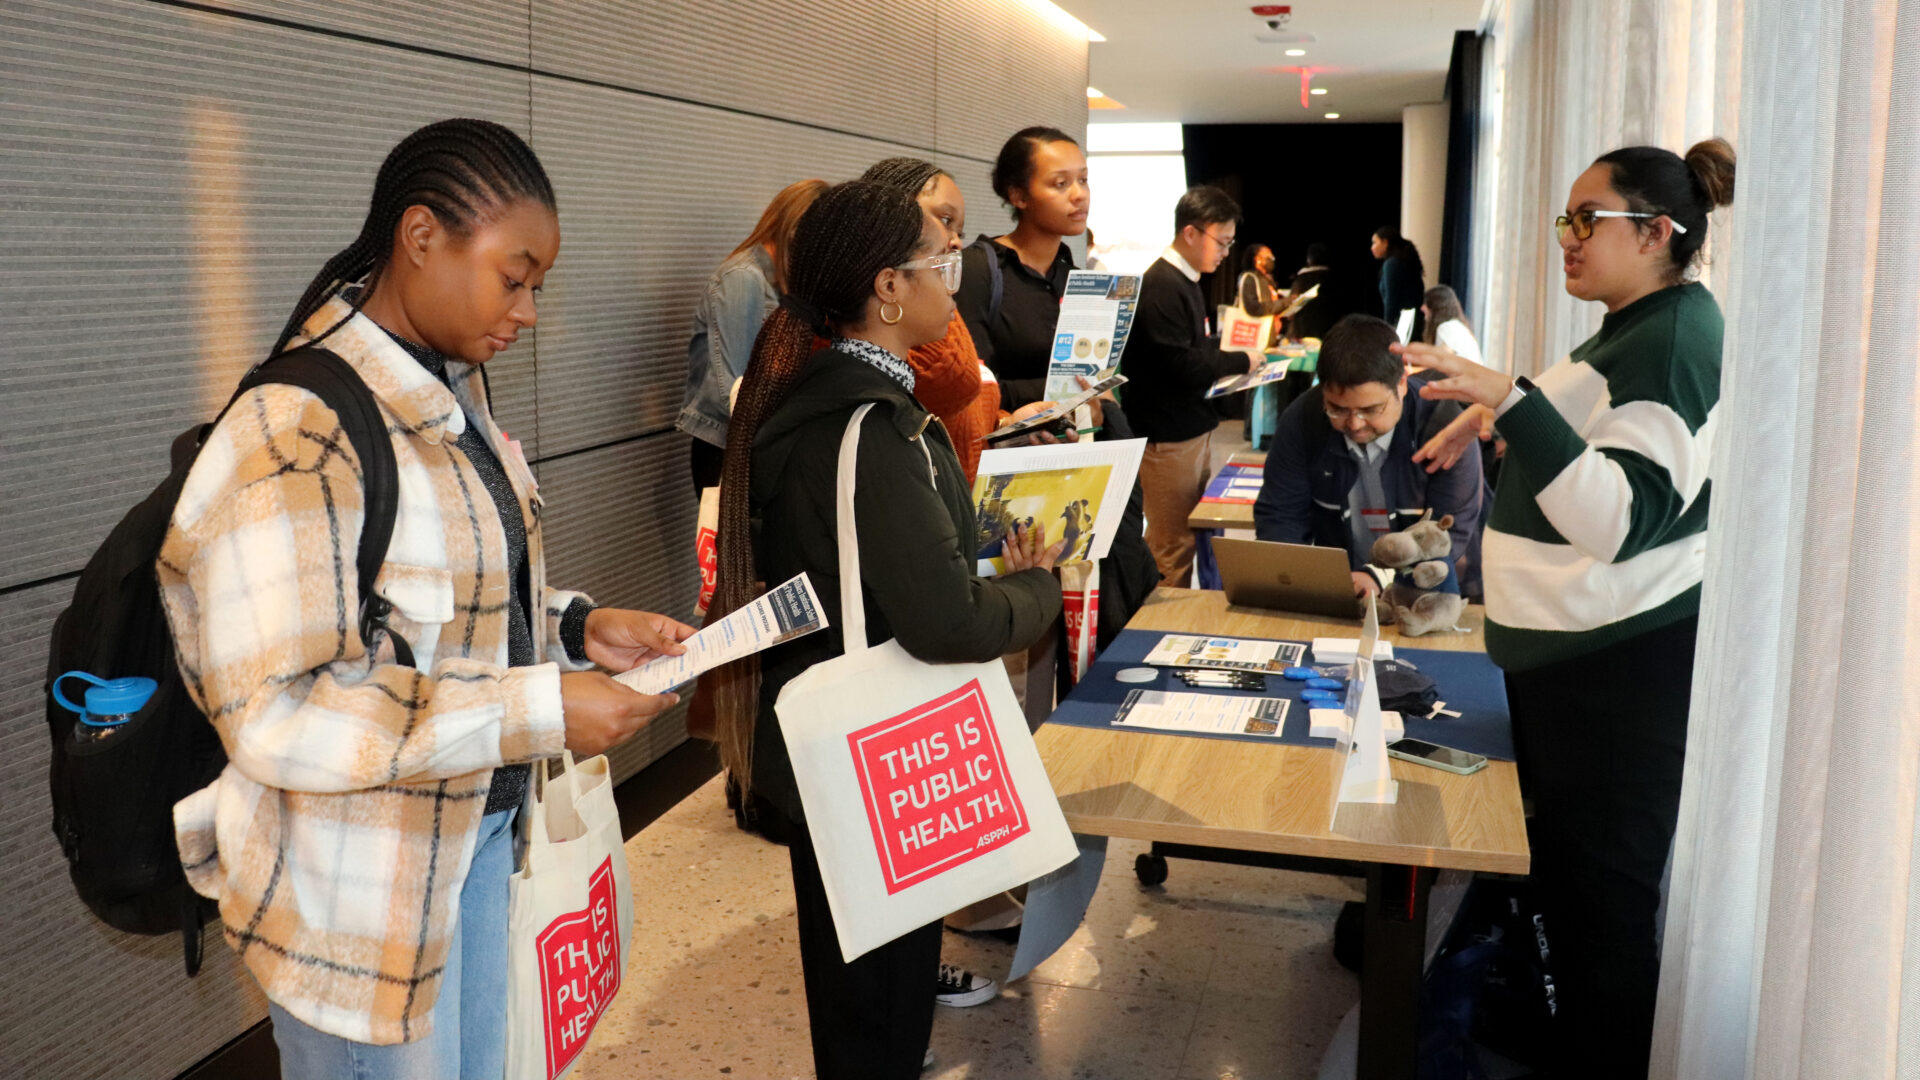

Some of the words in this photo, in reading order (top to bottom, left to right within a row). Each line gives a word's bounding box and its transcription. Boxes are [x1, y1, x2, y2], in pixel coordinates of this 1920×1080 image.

[879, 731, 949, 780] THIS
[954, 716, 981, 750] IS
[889, 754, 992, 820] PUBLIC
[898, 789, 1005, 855] HEALTH
[976, 824, 1010, 849] ASPPH
[591, 897, 608, 933] IS
[1532, 913, 1550, 964] UNDE
[557, 930, 612, 1016] PULIC
